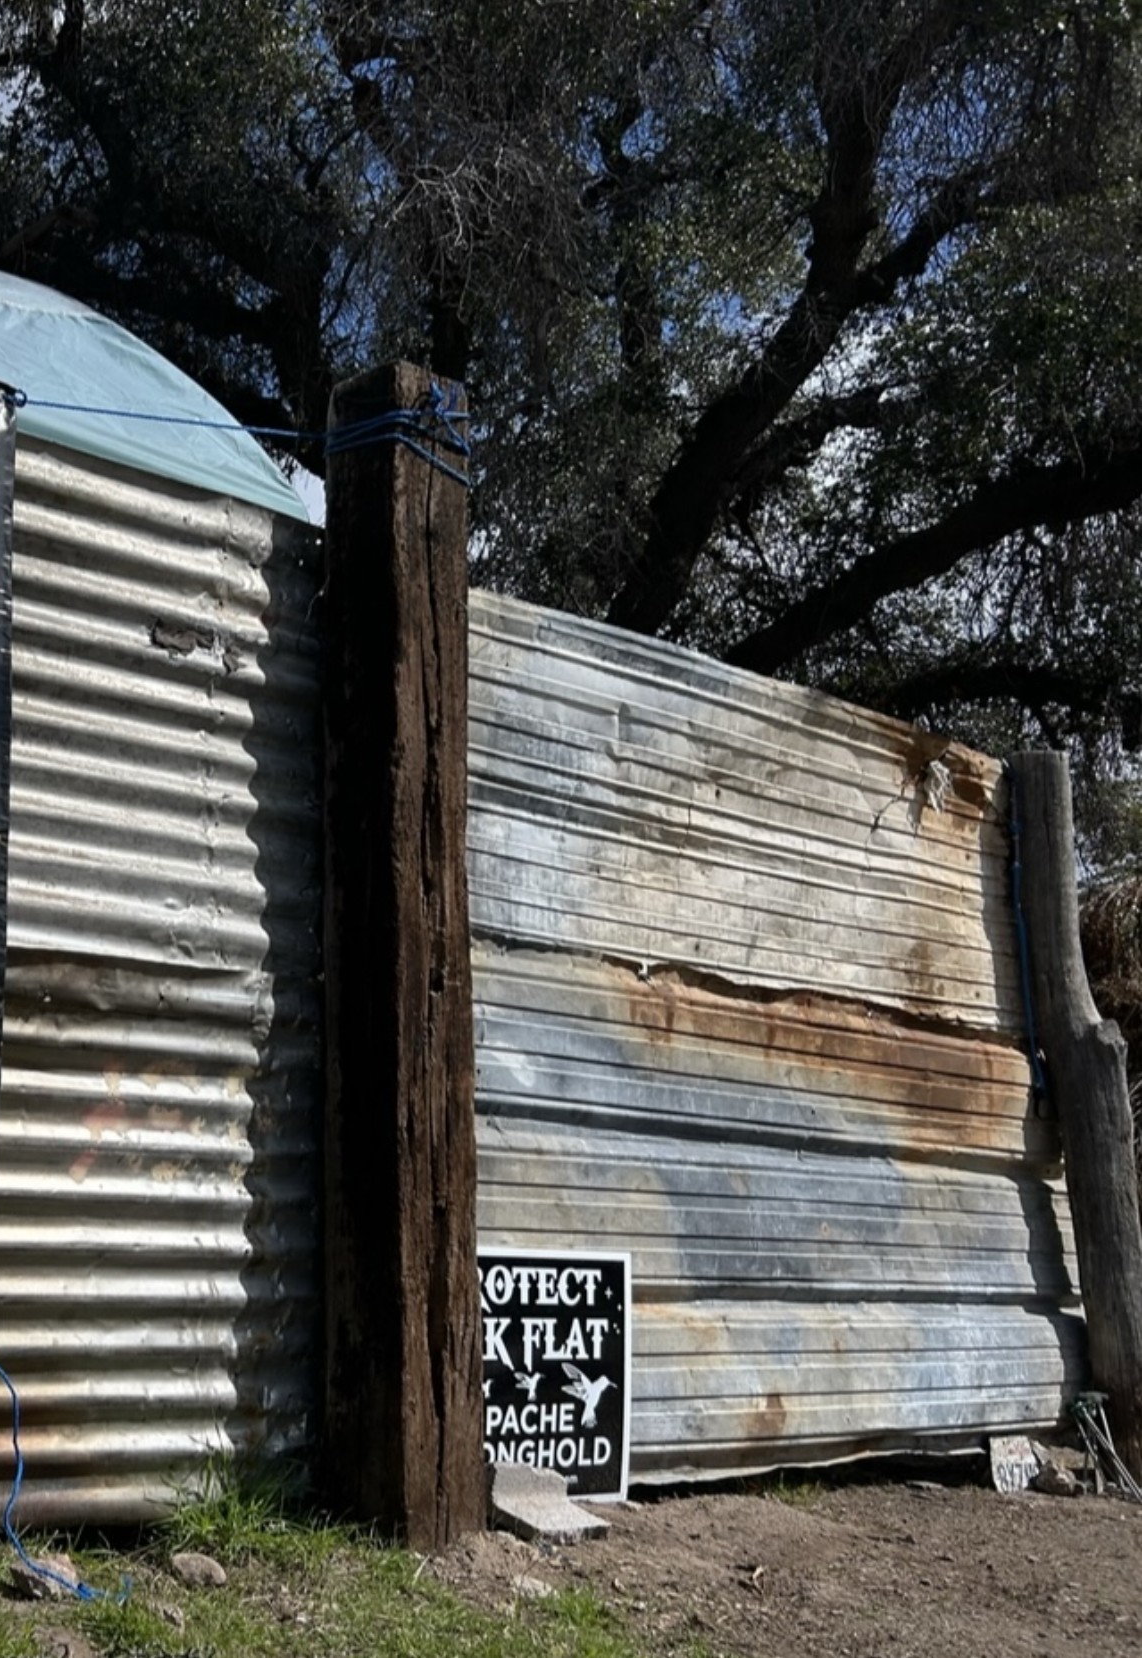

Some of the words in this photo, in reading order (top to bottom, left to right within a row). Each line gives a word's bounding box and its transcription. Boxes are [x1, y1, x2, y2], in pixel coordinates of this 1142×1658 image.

[477, 1264, 602, 1313] OTECT
[521, 1317, 609, 1372] FLAT
[485, 1403, 575, 1436] PACHE
[483, 1436, 611, 1468] ONGHOLD
